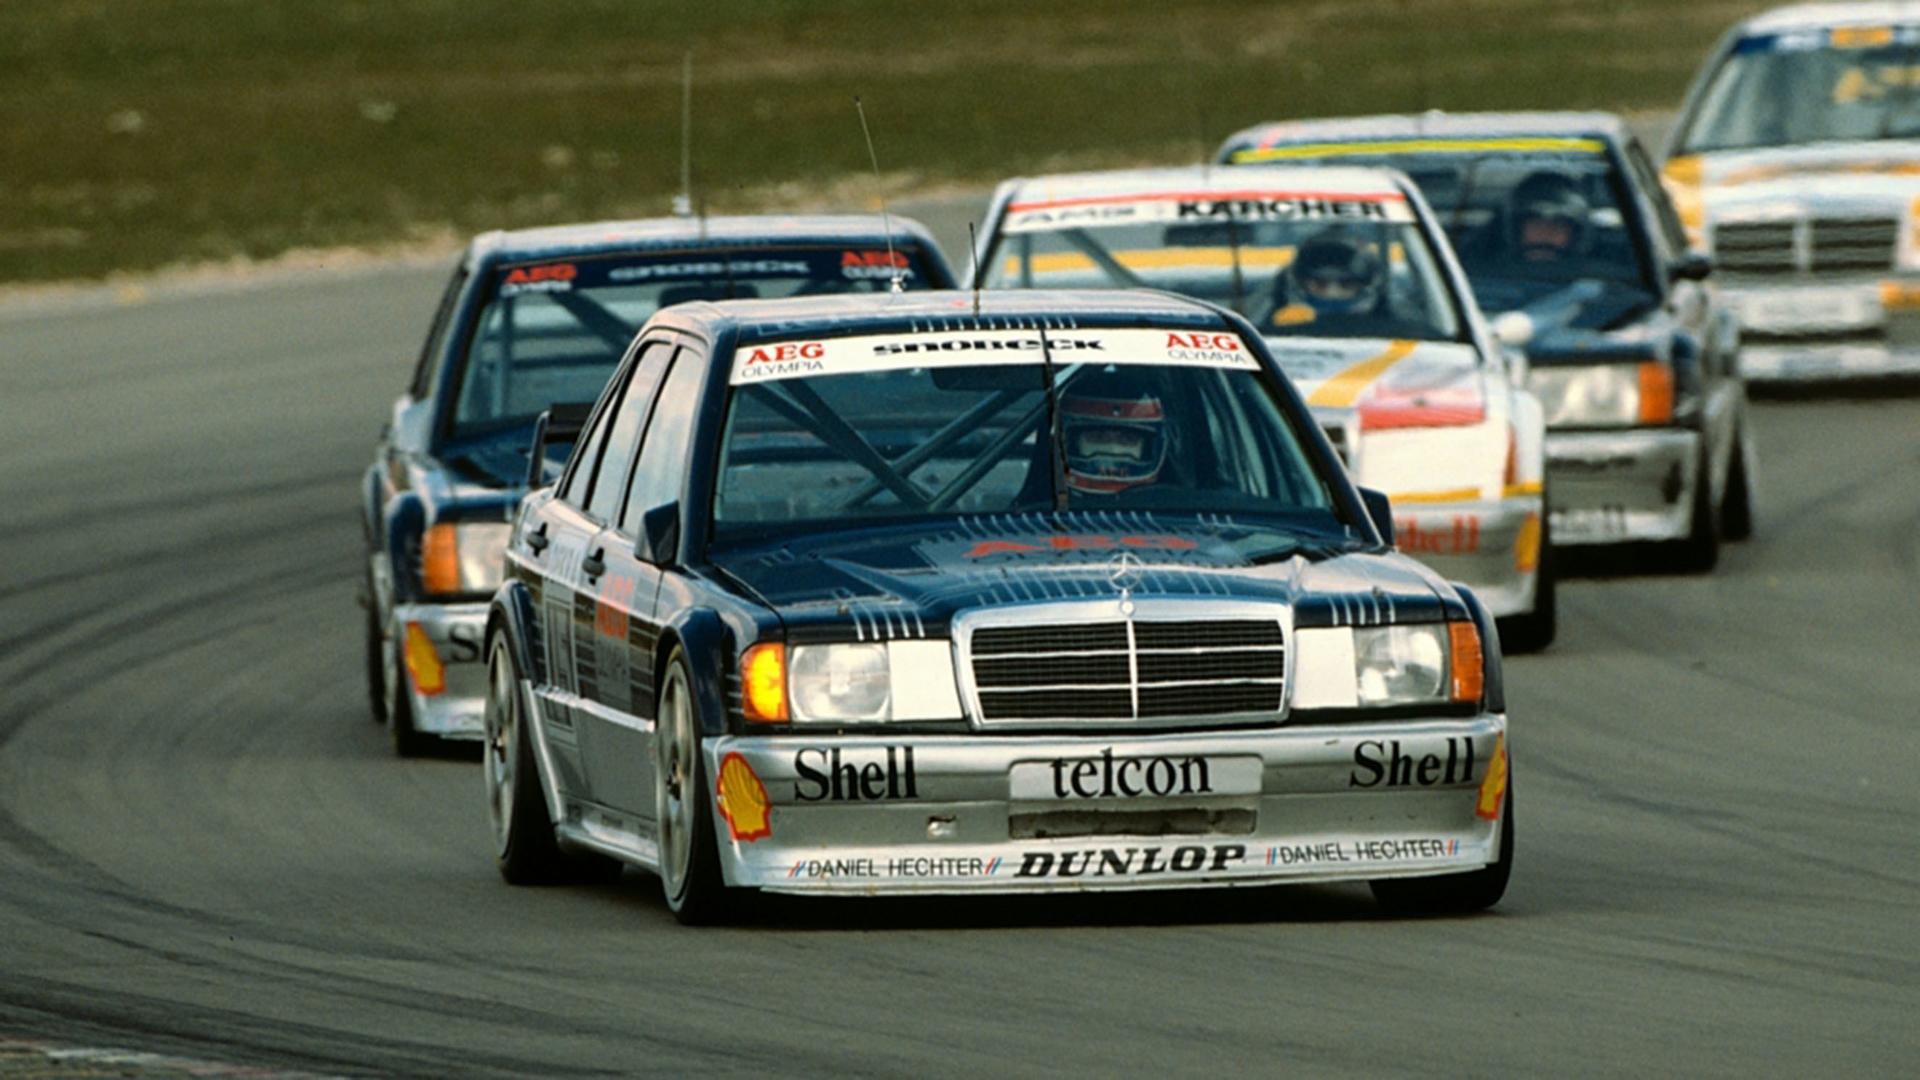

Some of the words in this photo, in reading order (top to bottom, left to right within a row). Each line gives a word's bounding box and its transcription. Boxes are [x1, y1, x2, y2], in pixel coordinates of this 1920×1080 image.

[746, 342, 825, 365] AEG
[1166, 332, 1239, 351] AEG
[742, 360, 824, 378] OLYMPIA
[1167, 350, 1248, 364] OLYMPIA
[795, 745, 919, 800] Shell
[1050, 747, 1213, 798] telcon
[1350, 736, 1475, 788] Shell
[1013, 845, 1246, 878] DUNLOP
[1279, 842, 1349, 864] DANIEL
[1356, 839, 1446, 860] HECHTER
[807, 860, 880, 877] DANIEL
[888, 857, 983, 877] HECHTER
